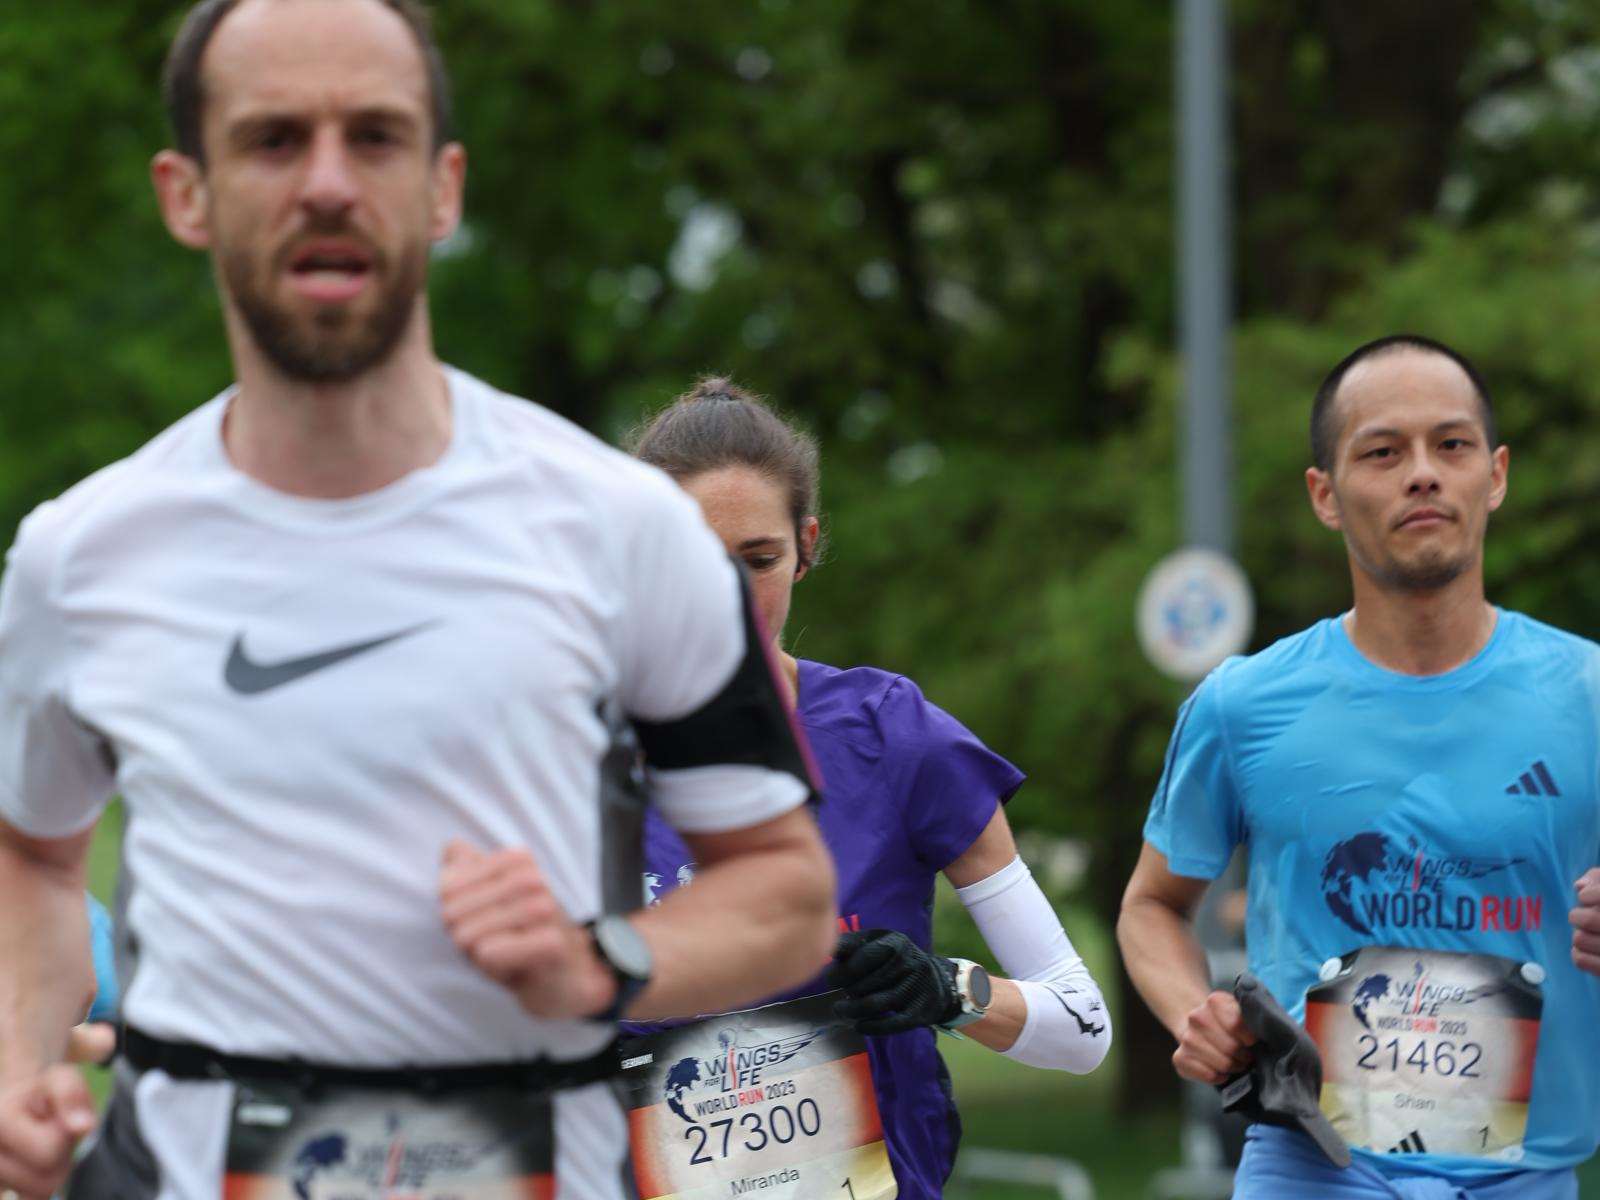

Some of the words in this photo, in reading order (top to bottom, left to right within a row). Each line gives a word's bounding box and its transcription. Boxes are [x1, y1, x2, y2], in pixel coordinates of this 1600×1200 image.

[704, 1044, 780, 1076] WINGS
[1357, 1034, 1482, 1078] 21462
[721, 1067, 762, 1092] LIFE
[765, 1080, 796, 1100] 2025
[1394, 1093, 1436, 1111] Shan
[684, 1098, 820, 1165] 27300
[1479, 1126, 1489, 1148] 1
[731, 1168, 800, 1196] Miranda
